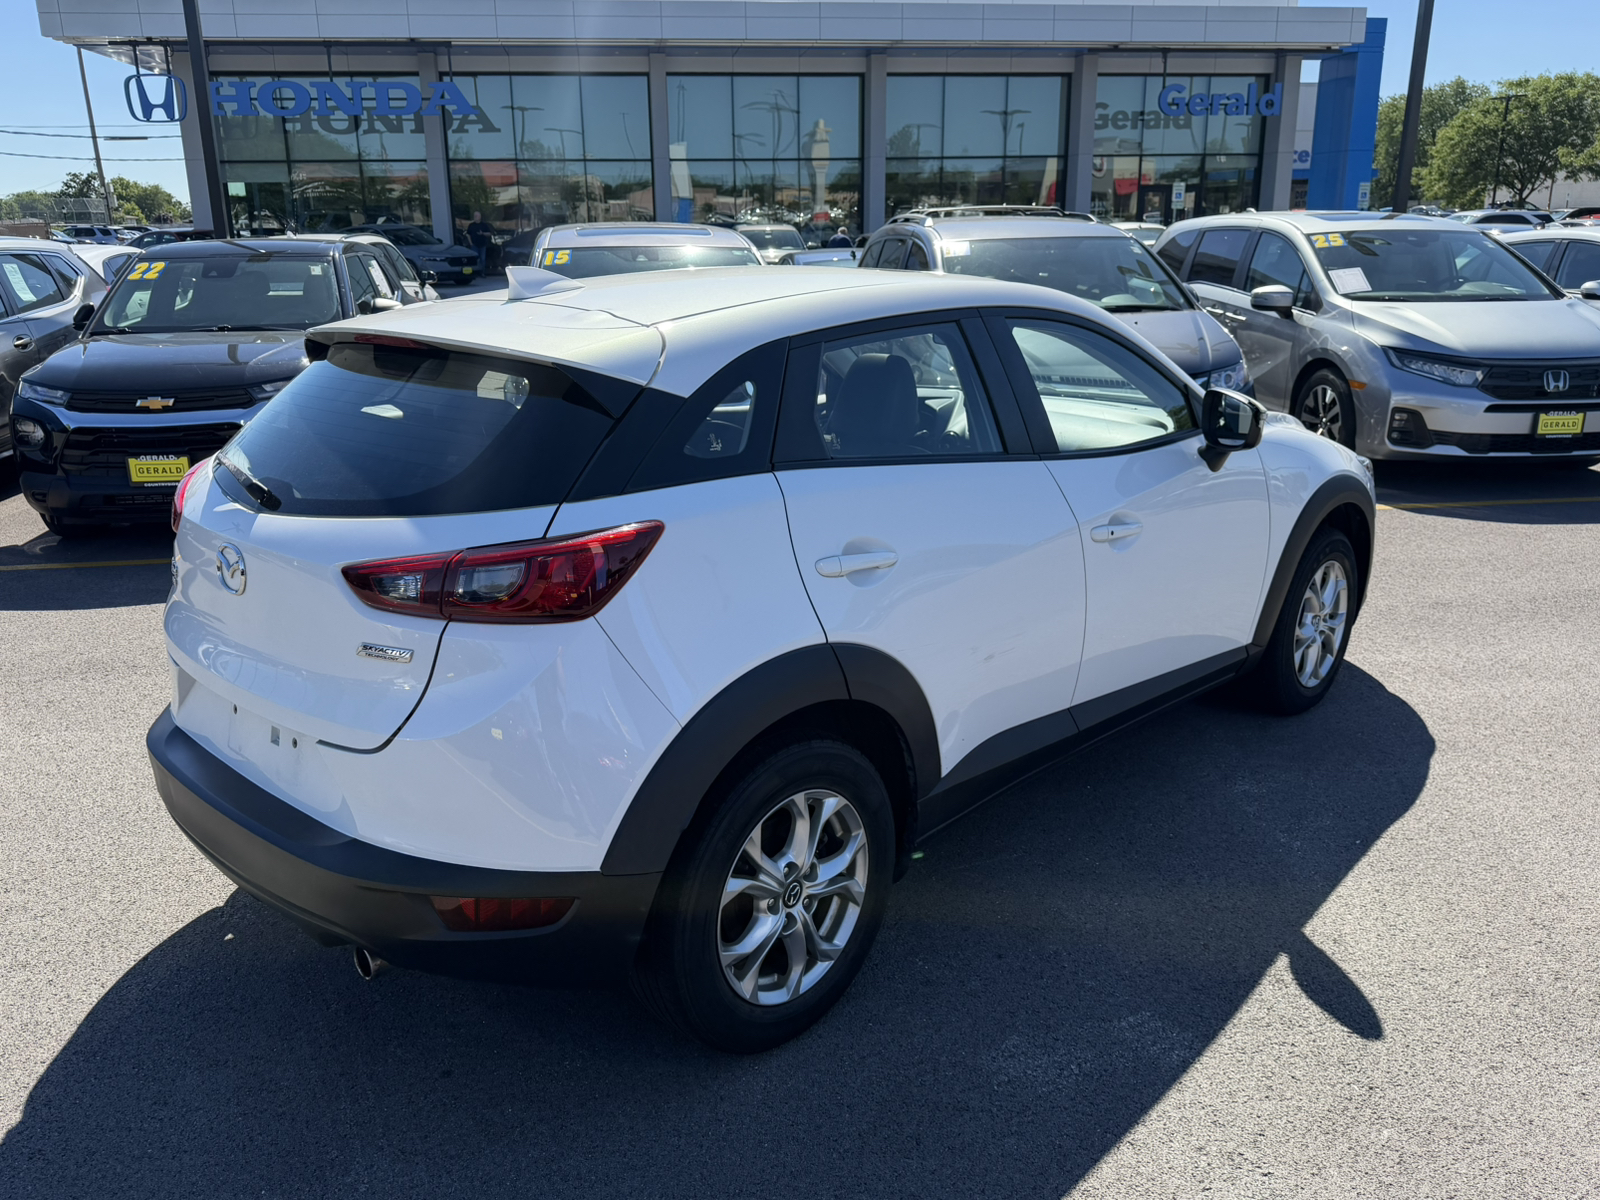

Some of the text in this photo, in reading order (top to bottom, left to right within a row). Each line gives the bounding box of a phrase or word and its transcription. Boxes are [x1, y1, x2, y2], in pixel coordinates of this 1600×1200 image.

[209, 80, 480, 116] HONDA
[1158, 83, 1283, 117] Gerald
[1309, 233, 1344, 248] 25
[544, 250, 571, 266] 15
[127, 261, 166, 280] 22
[138, 466, 182, 475] GERALD
[361, 644, 406, 656] SKYACTIV
